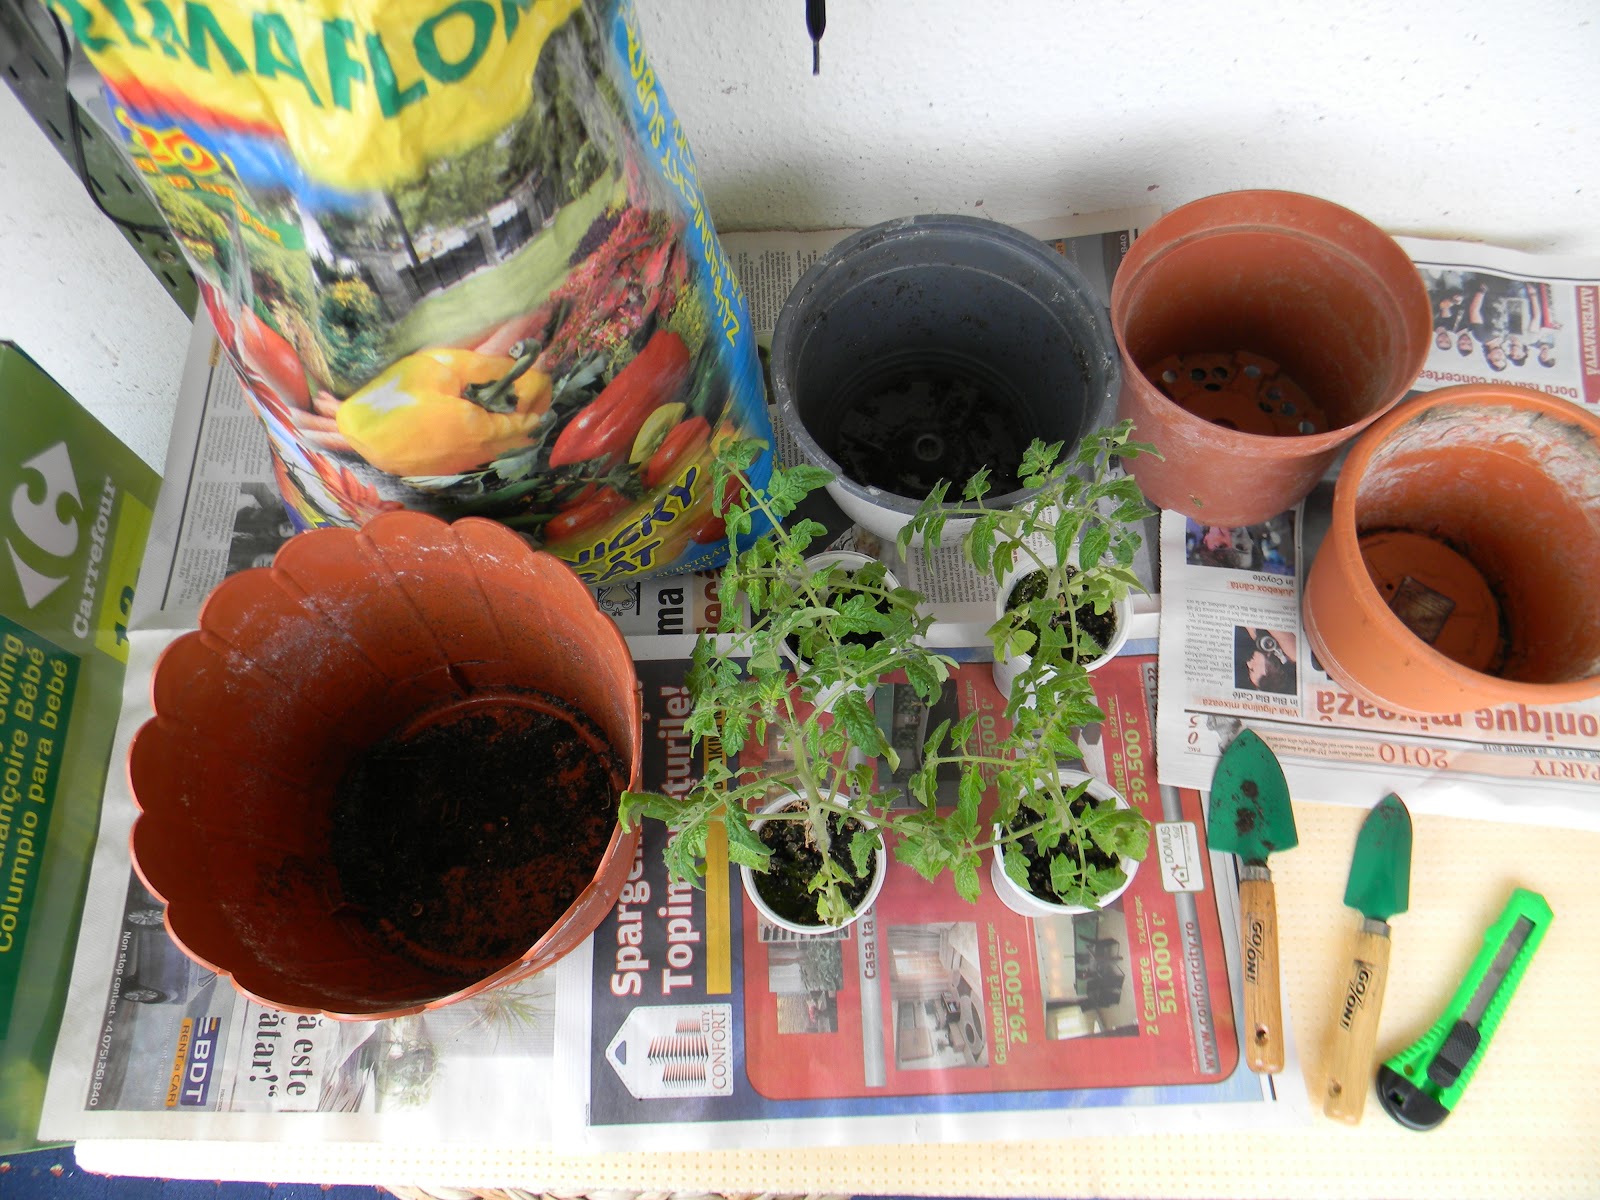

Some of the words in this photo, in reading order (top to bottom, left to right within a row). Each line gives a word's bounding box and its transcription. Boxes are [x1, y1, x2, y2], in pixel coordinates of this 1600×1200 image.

[73, 475, 117, 639] Carrefour
[1252, 575, 1283, 586] Coyote
[1256, 585, 1295, 596] Jukebox
[14, 646, 45, 722] Bébé
[40, 657, 68, 731] bebé
[28, 737, 53, 804] para
[1125, 730, 1149, 805] 39.500
[1378, 742, 1449, 769] 2010
[1160, 825, 1174, 864] DOMUS
[0, 811, 38, 952] Columpio
[122, 931, 132, 948] Non
[862, 920, 874, 937] ta
[116, 951, 127, 975] stop
[862, 942, 877, 980] Casa
[1137, 957, 1159, 1021] Camere
[1151, 932, 1179, 1015] 51.000
[702, 1011, 710, 1032] CITY
[985, 975, 1007, 1066] Garsonieră
[1004, 961, 1029, 1044] 29.500
[1182, 920, 1217, 1071] www.confortcity.ro
[178, 1024, 191, 1062] RENT
[286, 1038, 314, 1097] este
[712, 1009, 727, 1090] CONFORT
[168, 1073, 181, 1103] CAR
